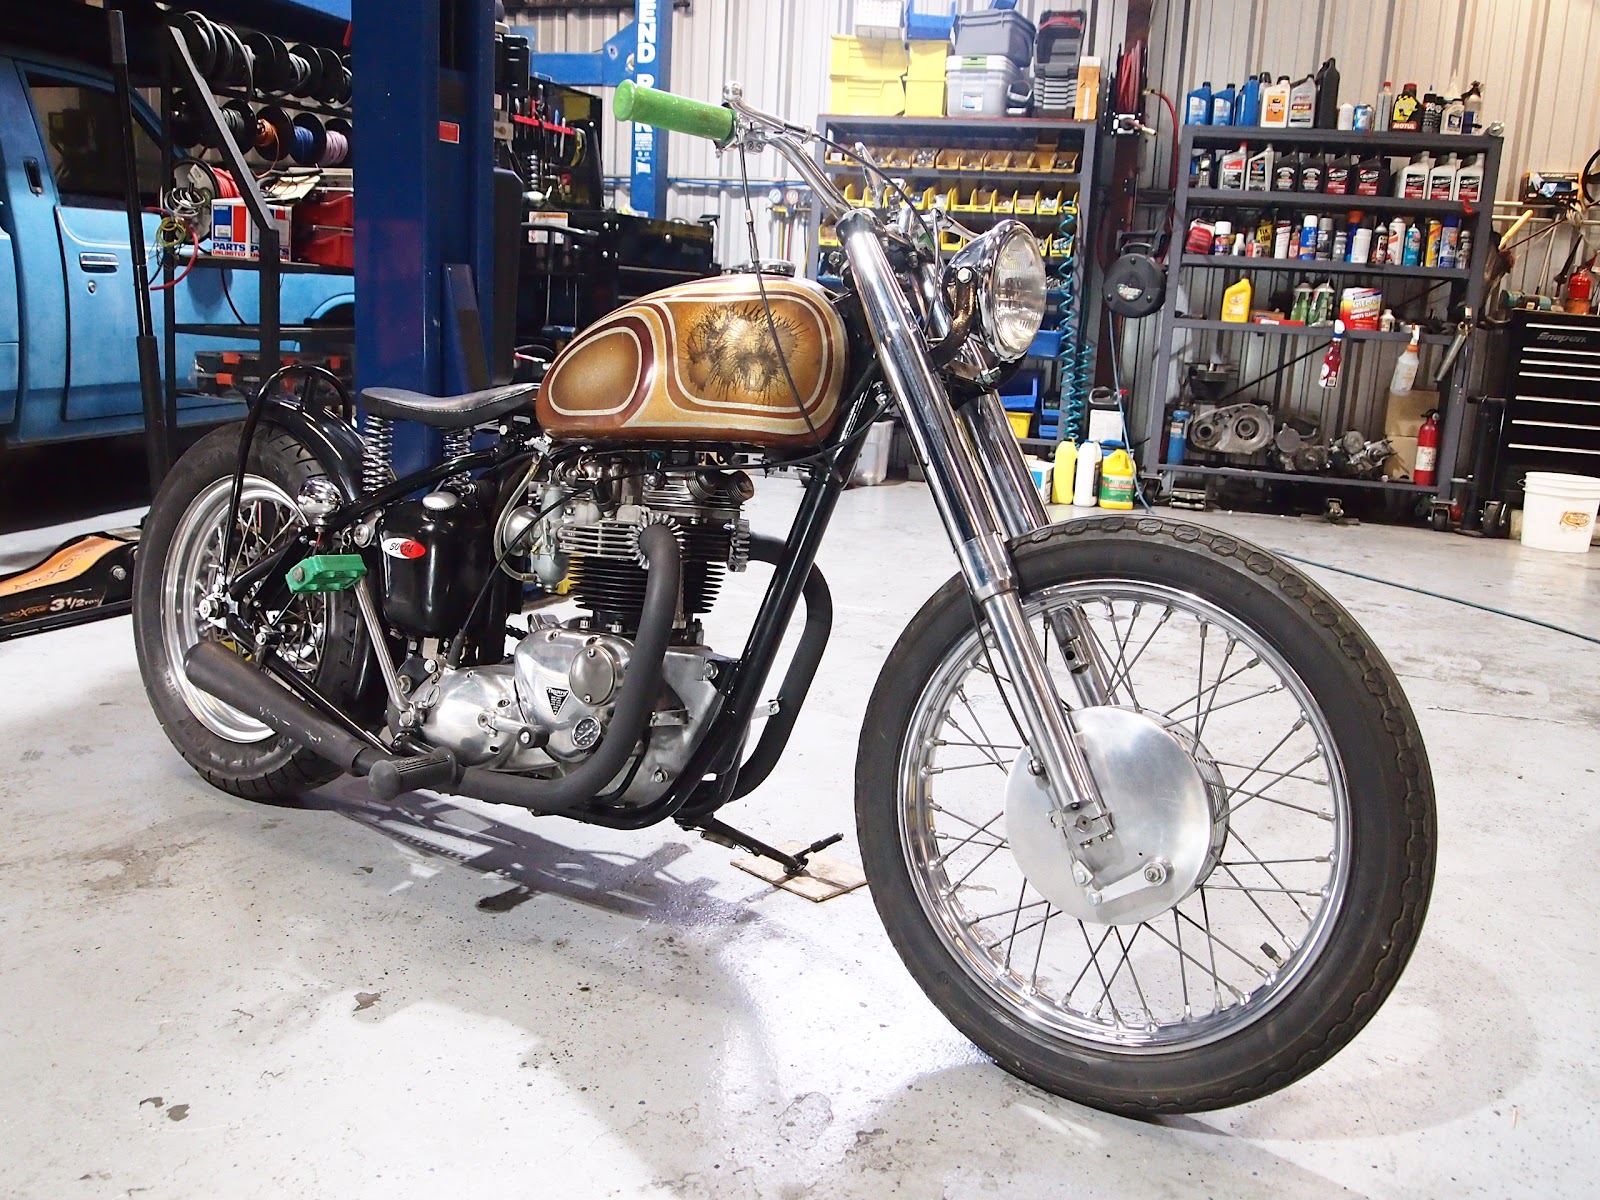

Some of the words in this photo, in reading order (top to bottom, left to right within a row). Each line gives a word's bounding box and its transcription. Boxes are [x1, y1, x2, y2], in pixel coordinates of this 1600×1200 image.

[637, 0, 657, 64] END
[1392, 122, 1416, 130] MOTUL
[213, 242, 246, 252] PARTS
